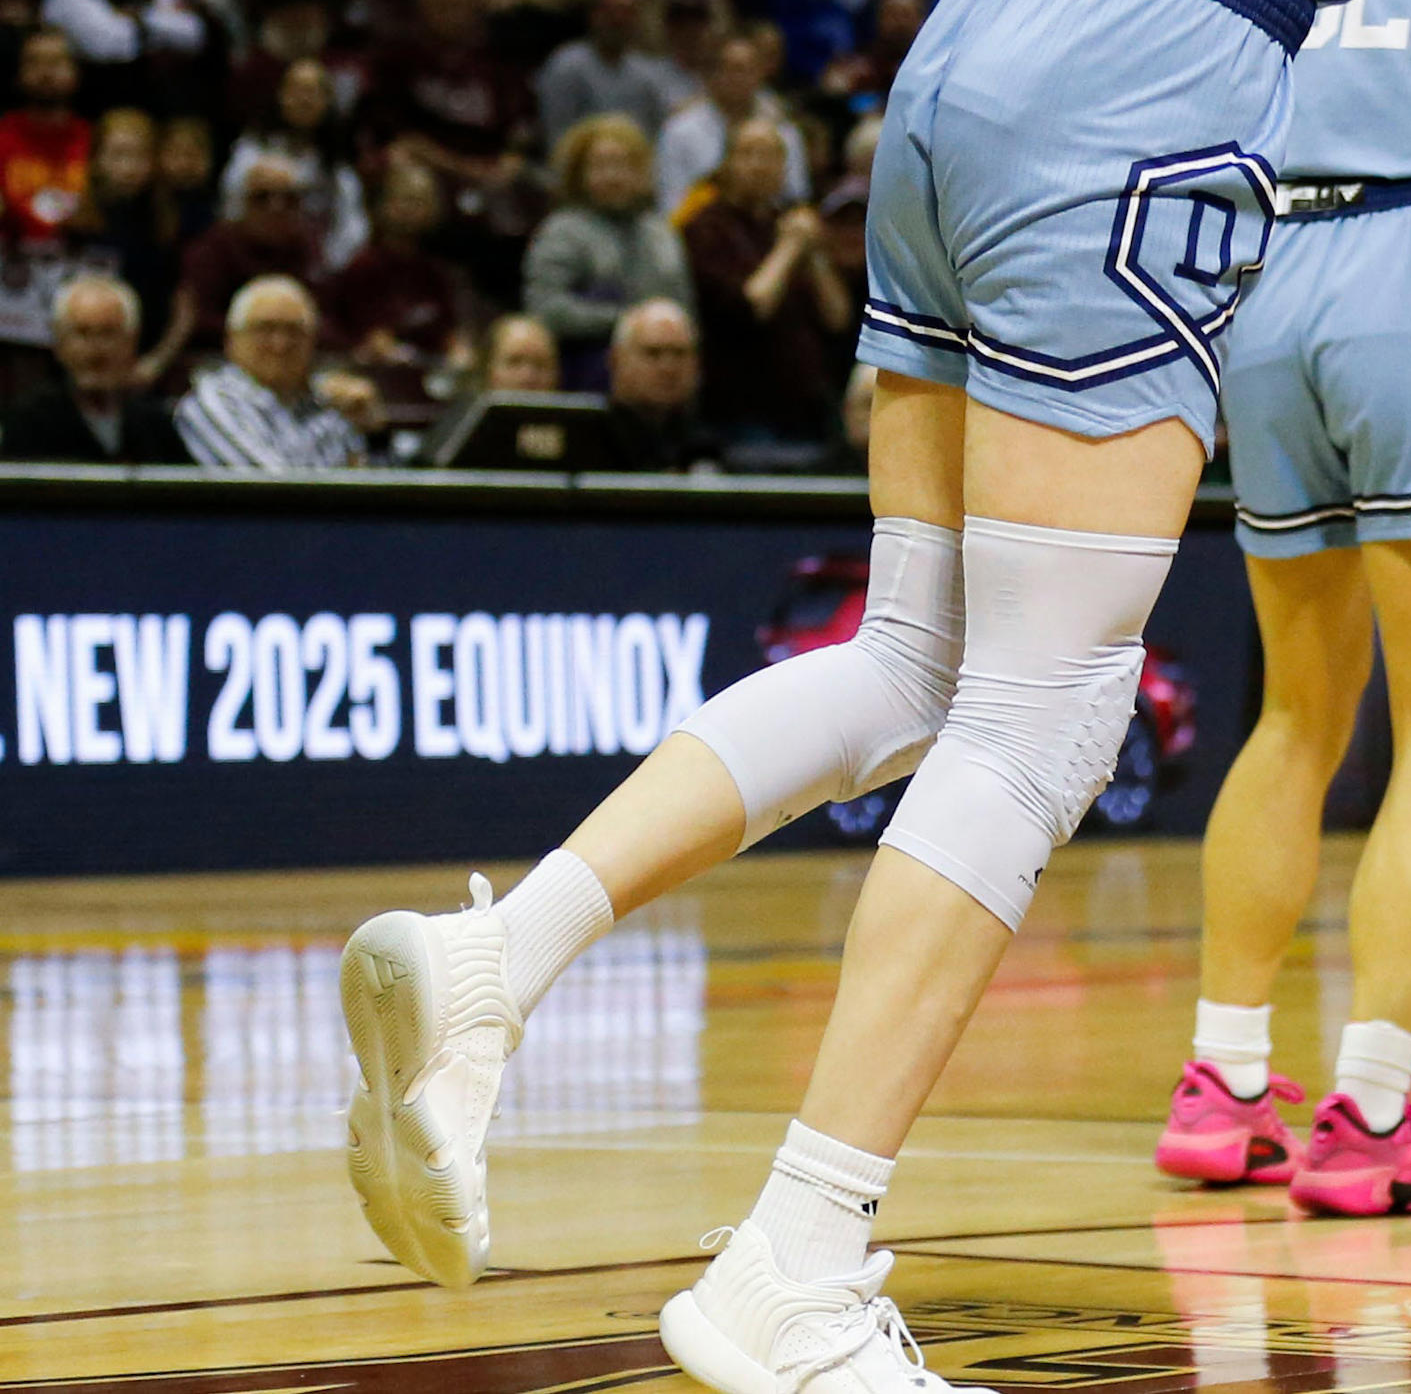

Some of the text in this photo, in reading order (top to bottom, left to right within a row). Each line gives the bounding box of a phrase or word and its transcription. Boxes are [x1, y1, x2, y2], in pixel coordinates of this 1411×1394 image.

[14, 611, 709, 765] NEW 2025 EQUINOX
